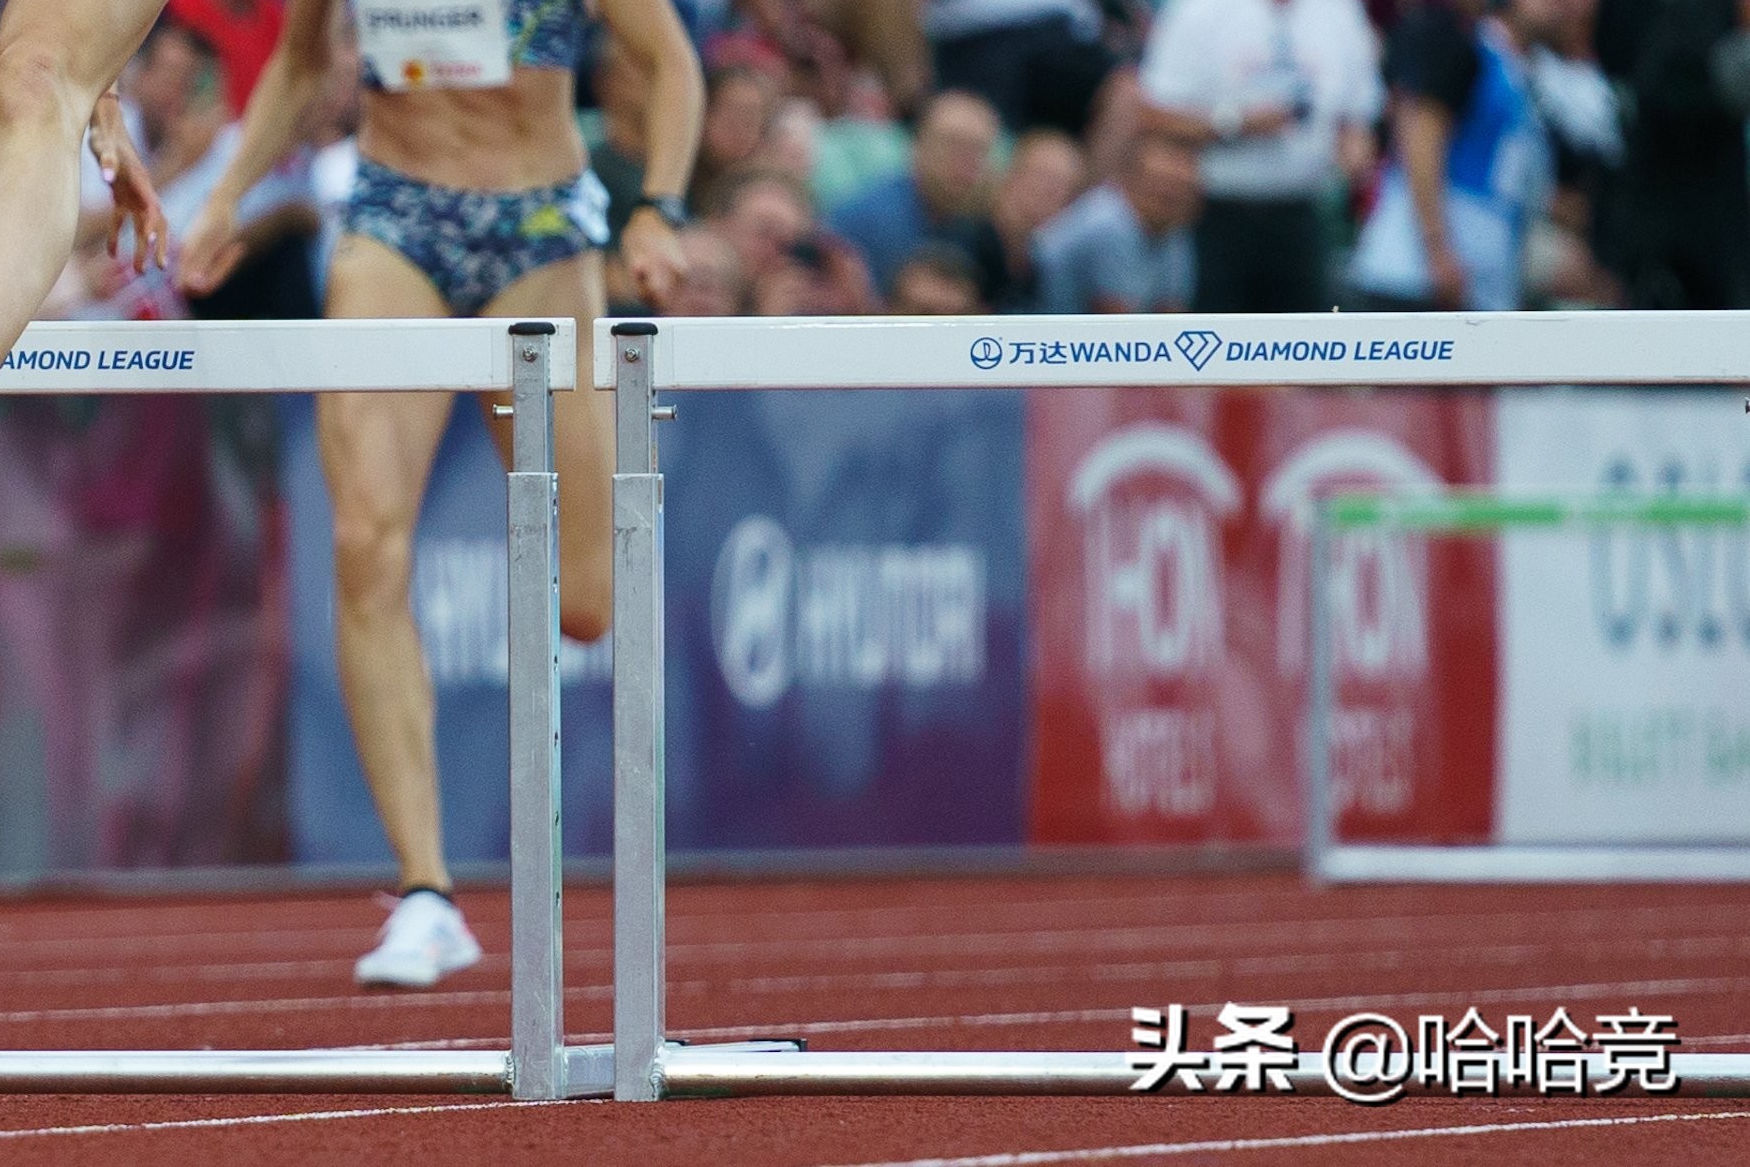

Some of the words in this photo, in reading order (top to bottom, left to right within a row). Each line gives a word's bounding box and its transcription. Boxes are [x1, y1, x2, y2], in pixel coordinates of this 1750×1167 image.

[3, 350, 91, 371] AMOND
[97, 349, 196, 371] LEAGUE
[1226, 339, 1347, 363] DIAMOND
[1353, 339, 1456, 362] LEAGUE
